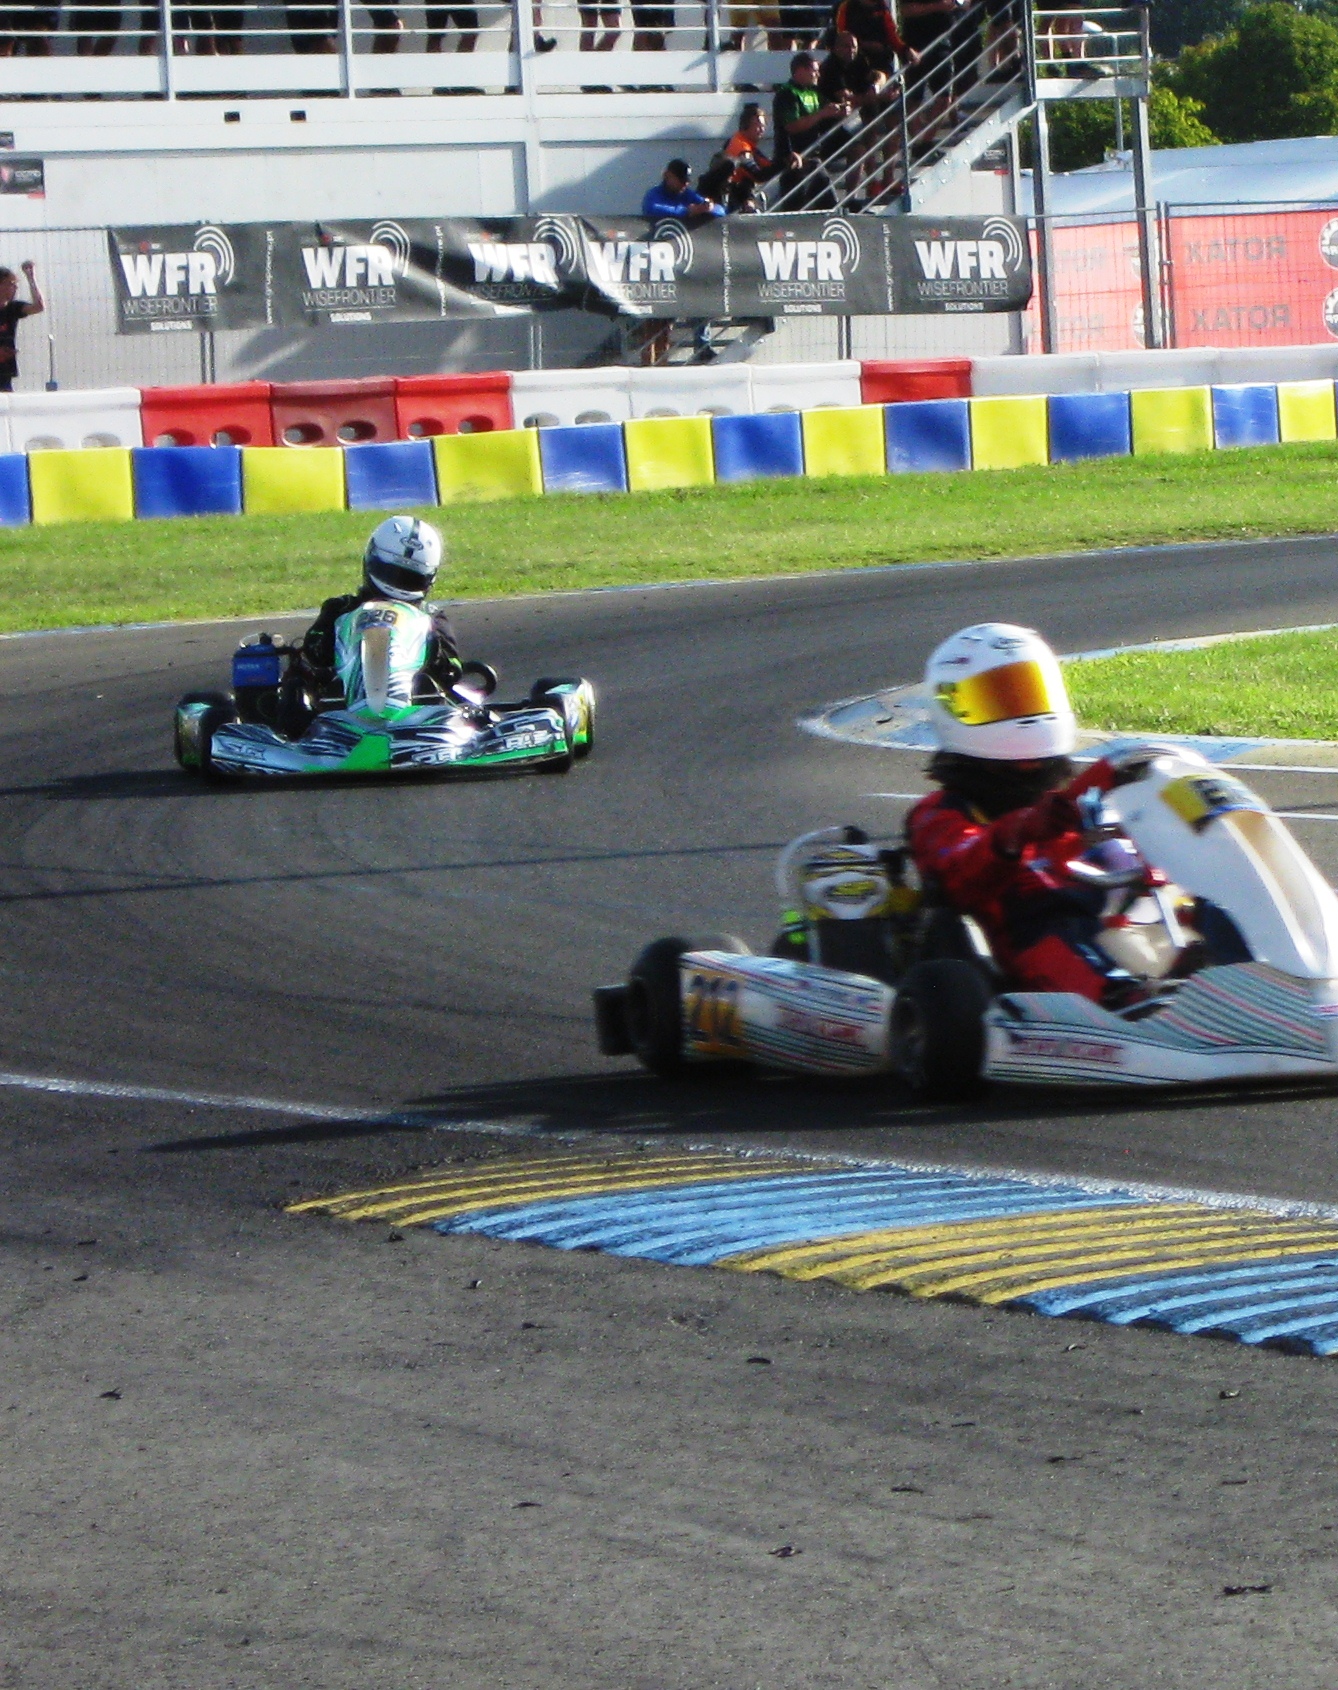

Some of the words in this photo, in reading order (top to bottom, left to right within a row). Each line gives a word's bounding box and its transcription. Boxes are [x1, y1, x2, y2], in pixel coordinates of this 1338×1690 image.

[120, 252, 217, 297] WFR
[302, 245, 395, 288] WFR
[467, 243, 559, 288] WFR
[588, 241, 675, 281] WFR
[757, 241, 844, 280] WFR
[914, 240, 1008, 279] WFR
[612, 283, 677, 300] FRONTIER
[758, 282, 845, 298] WISEFRONTIER
[917, 280, 1008, 296] WISEFRONTIER
